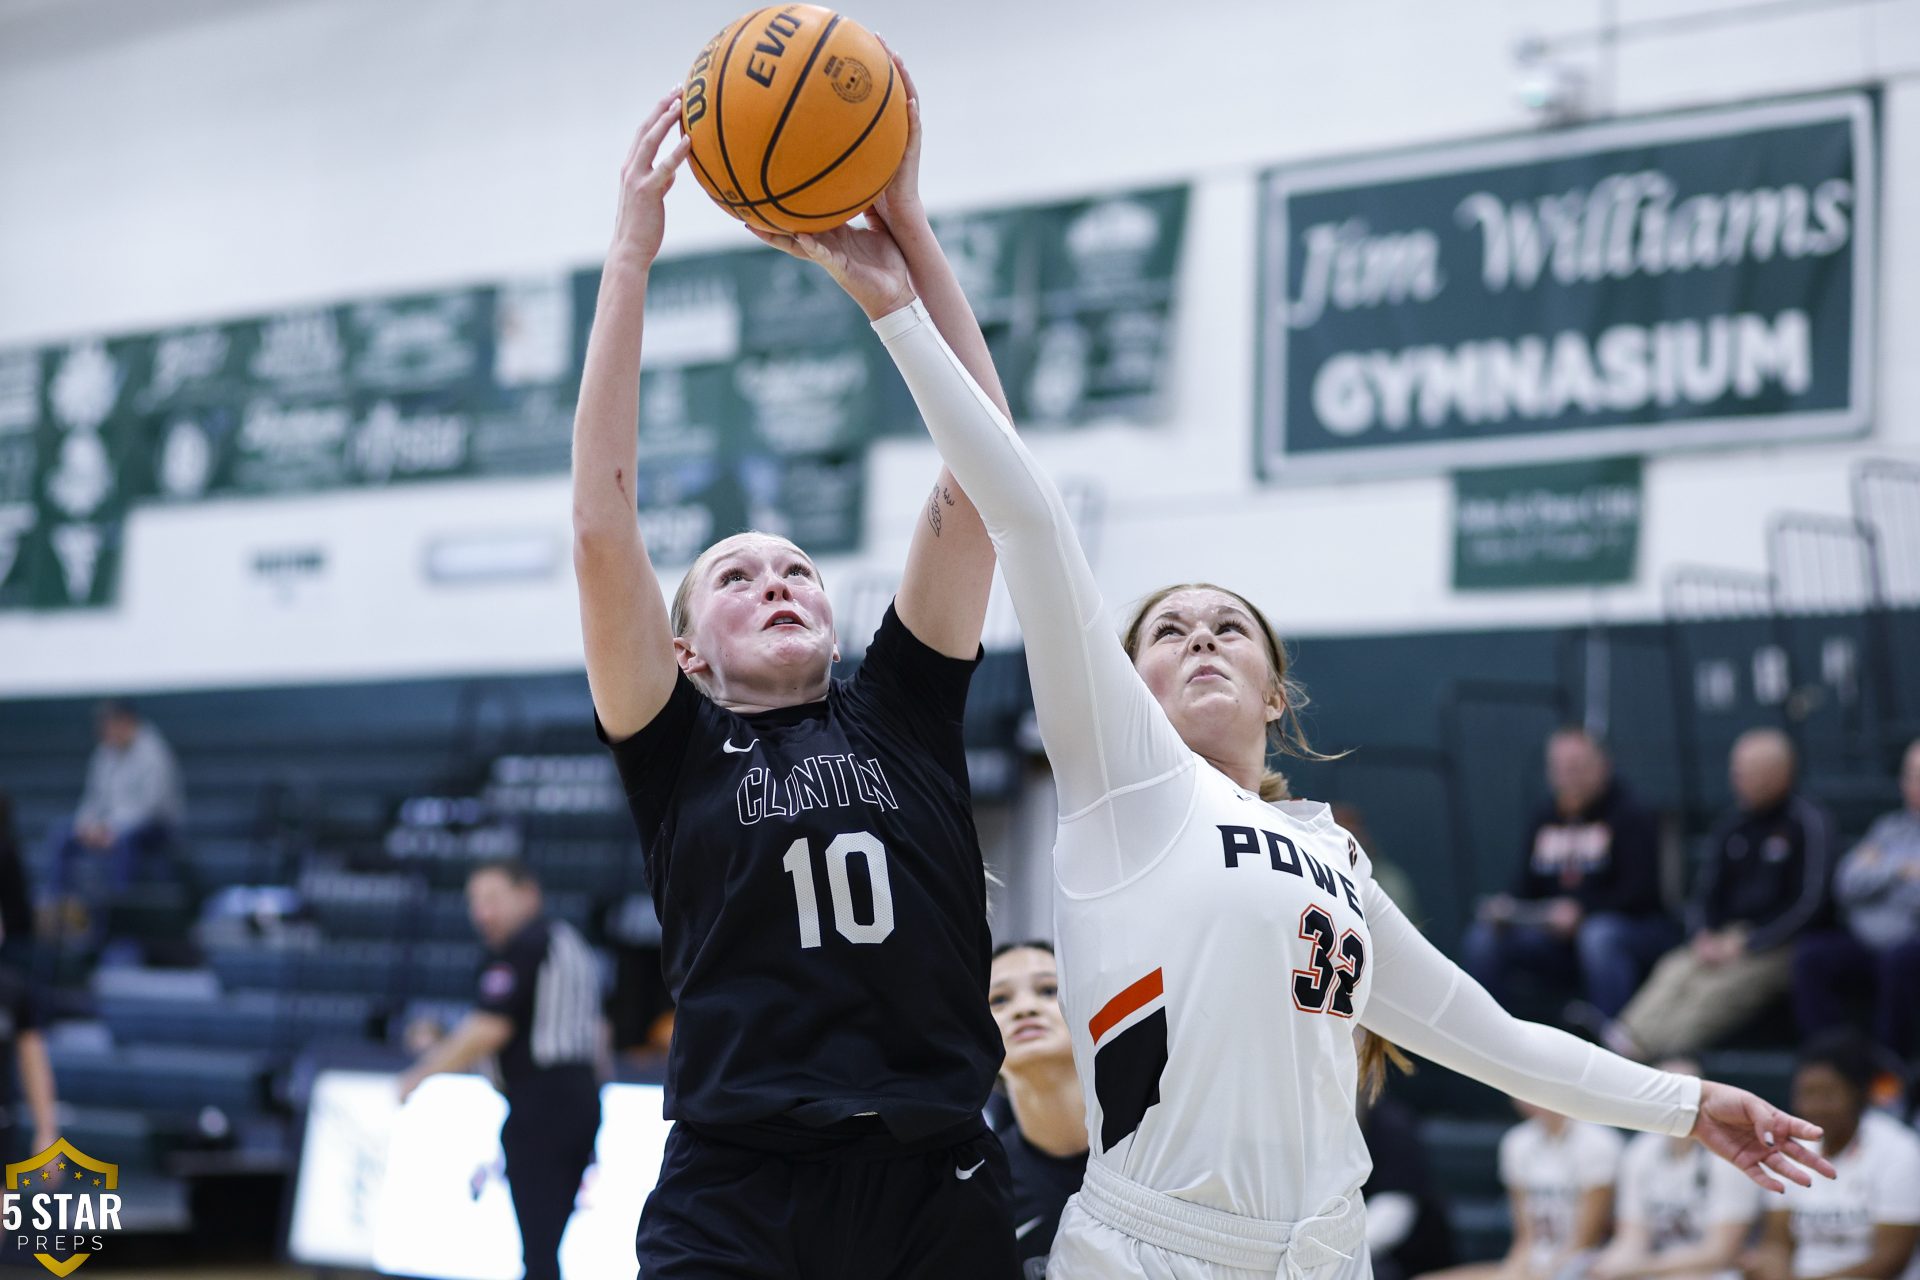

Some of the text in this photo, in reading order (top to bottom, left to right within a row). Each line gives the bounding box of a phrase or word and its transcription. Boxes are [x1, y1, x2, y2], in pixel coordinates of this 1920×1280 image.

[746, 13, 801, 88] EVO
[1286, 216, 1444, 326] Jim
[1456, 170, 1851, 289] Williams
[1313, 310, 1811, 435] GYMNASIUM
[783, 831, 894, 948] 10
[1292, 903, 1366, 1018] 32
